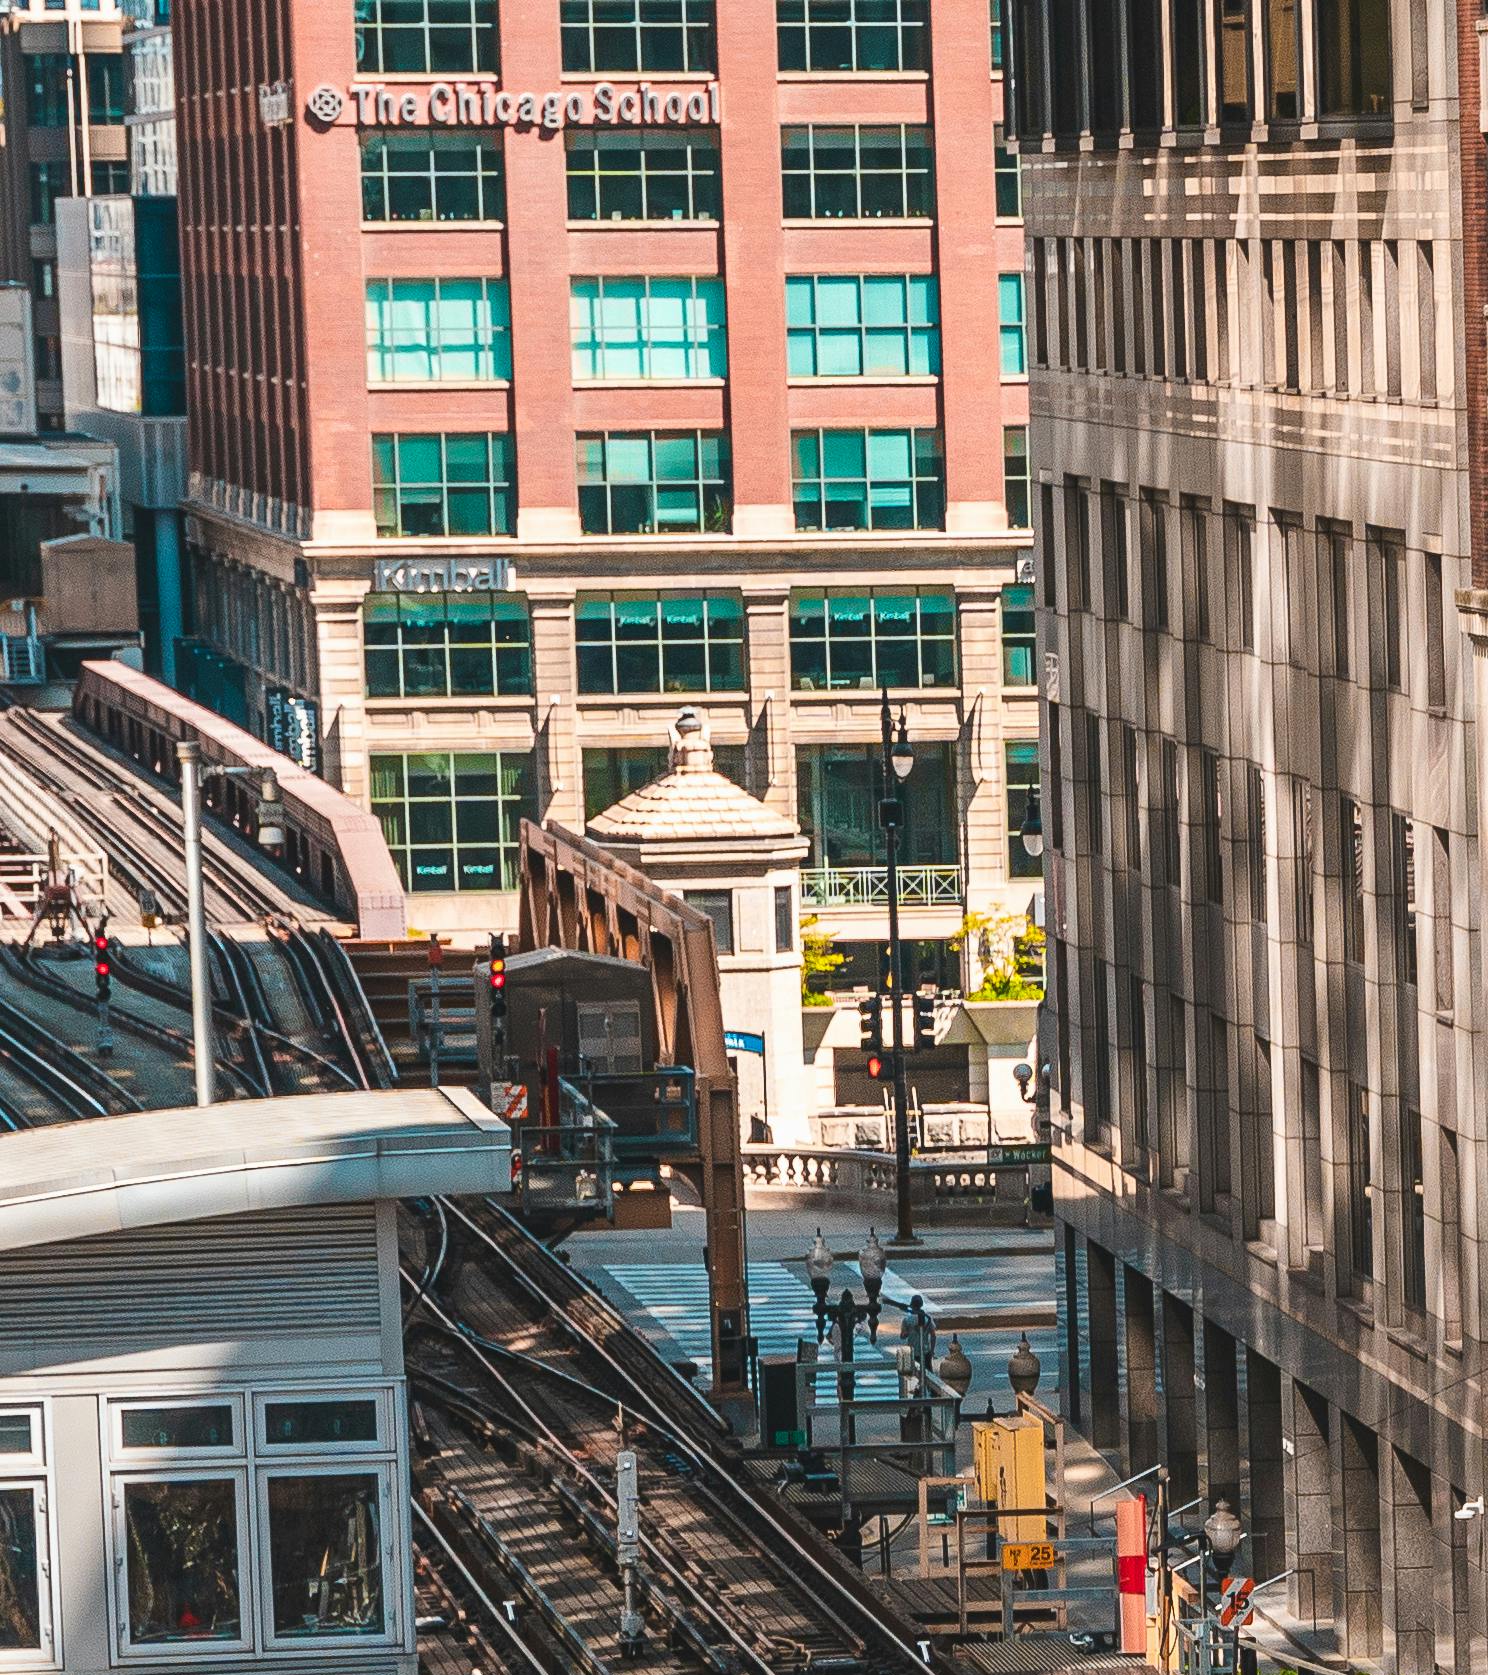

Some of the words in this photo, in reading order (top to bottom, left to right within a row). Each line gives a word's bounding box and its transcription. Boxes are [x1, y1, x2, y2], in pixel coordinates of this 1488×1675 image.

[350, 83, 418, 125] The
[429, 82, 584, 129] Chicago
[594, 81, 720, 125] School
[375, 558, 516, 592] Kimball
[1013, 1149, 1047, 1160] Wacker
[1030, 1546, 1051, 1561] 25
[1226, 1591, 1250, 1613] 15
